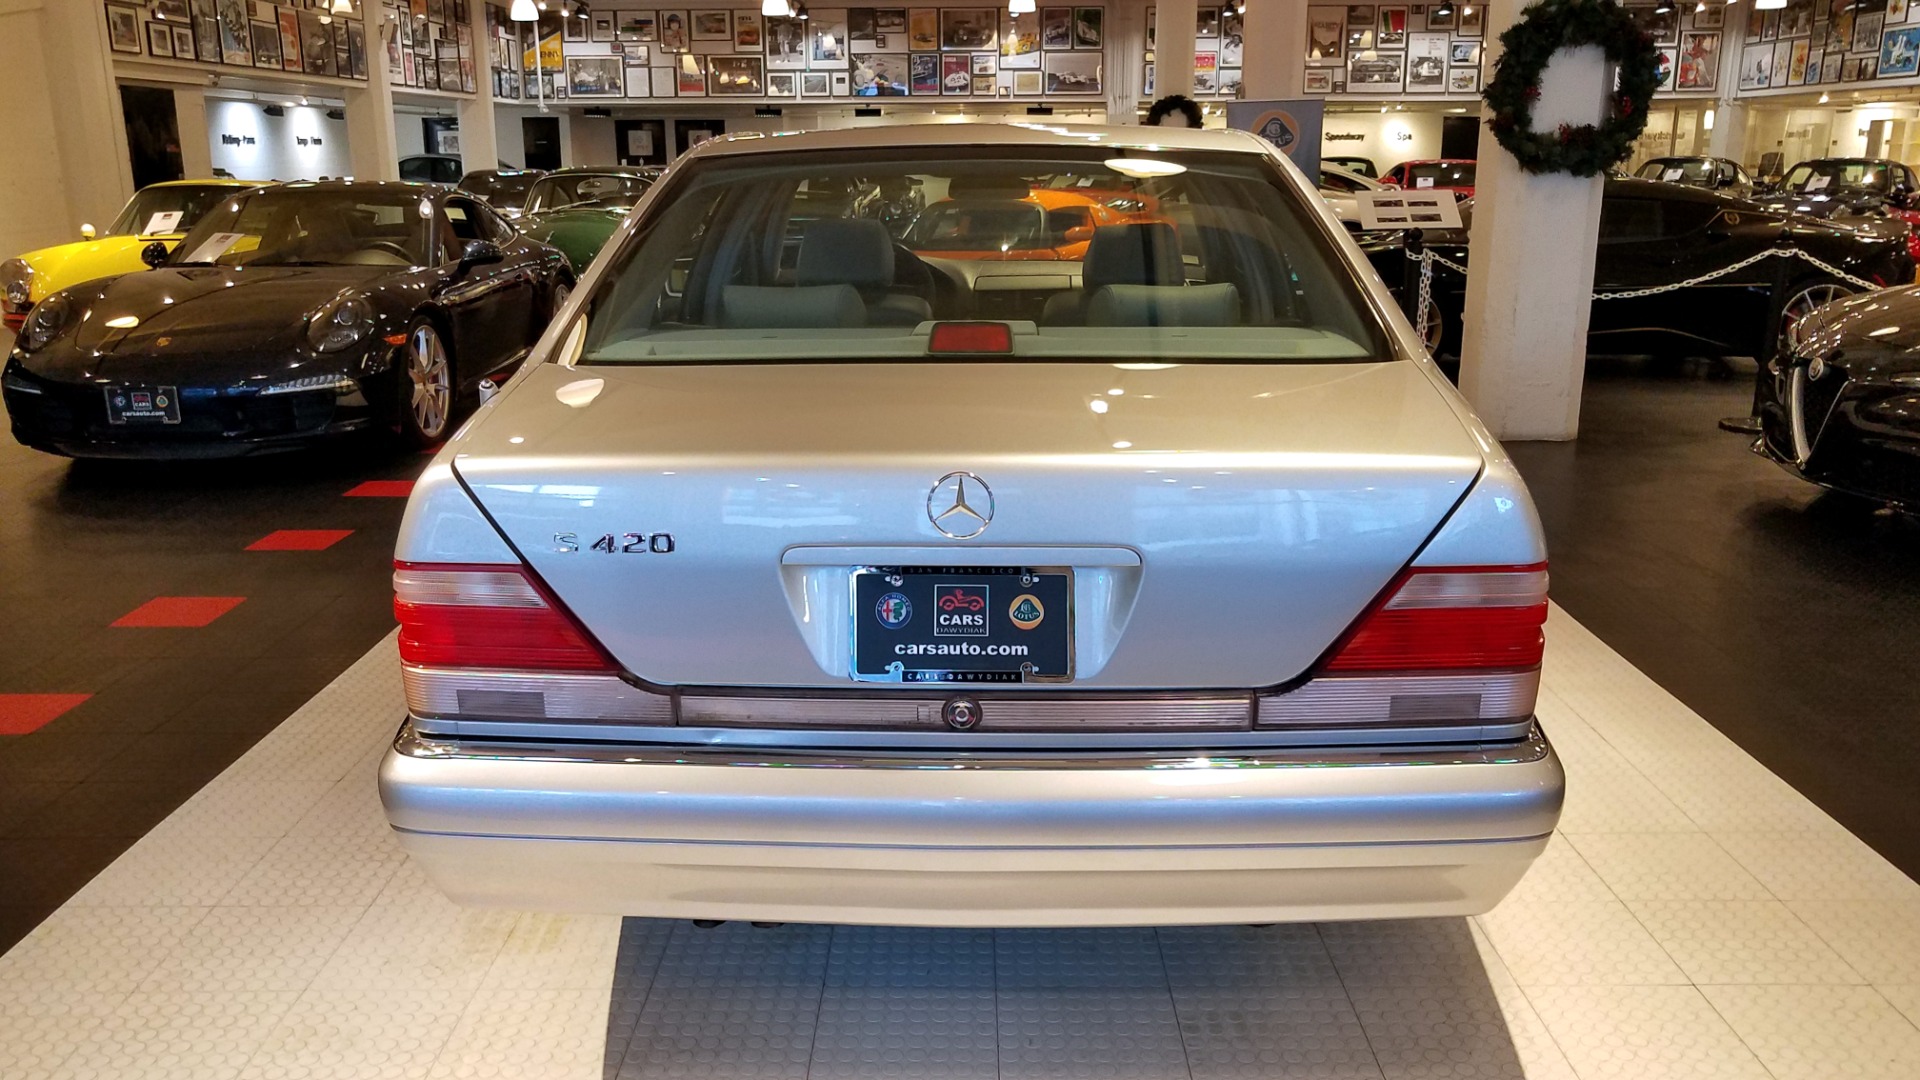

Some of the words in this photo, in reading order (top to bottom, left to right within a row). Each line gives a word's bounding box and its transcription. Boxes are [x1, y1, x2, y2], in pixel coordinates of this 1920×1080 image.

[1325, 131, 1365, 142] Speedway
[1396, 131, 1412, 141] Spa
[553, 531, 579, 553] S
[589, 531, 676, 554] 420
[891, 594, 911, 611] ROMEO
[939, 614, 984, 626] CARS
[1014, 610, 1040, 620] LOTUS
[894, 641, 1029, 656] carsauto.com
[907, 673, 939, 681] CARS
[948, 673, 1018, 681] DAWYDIAK
